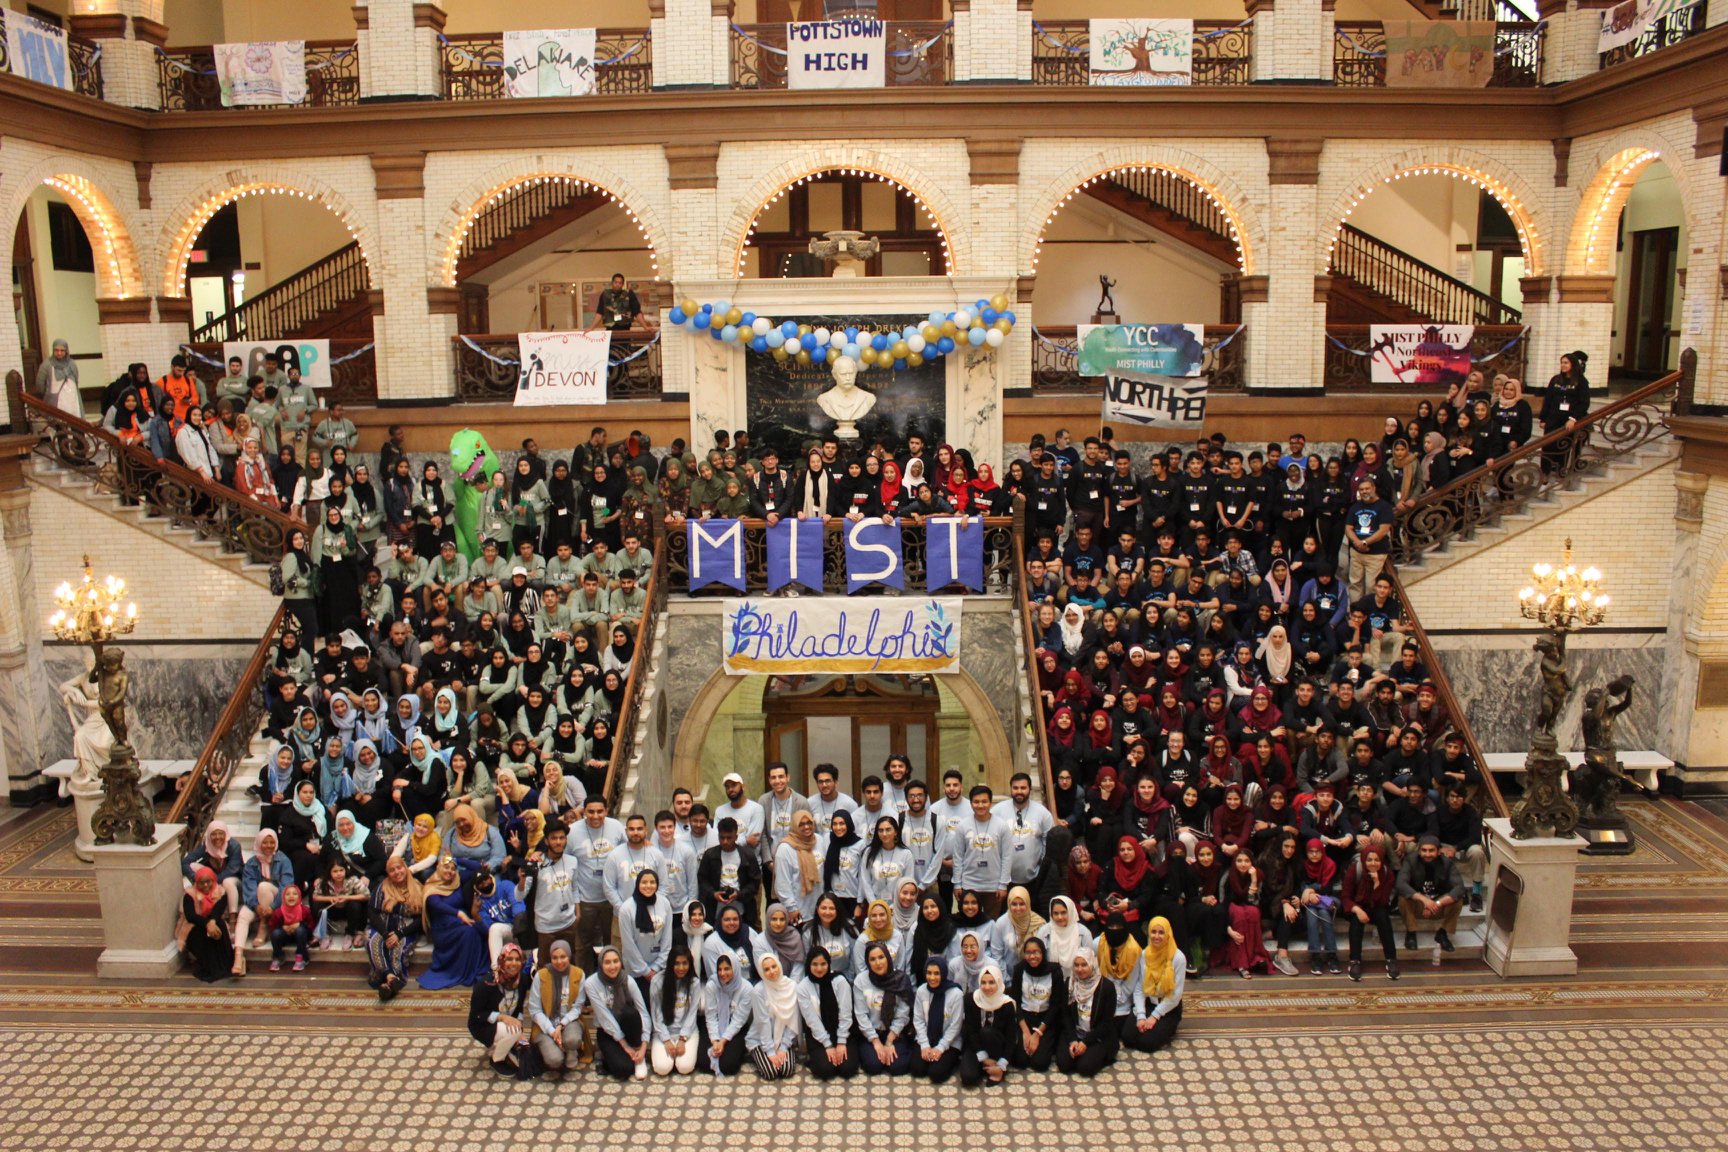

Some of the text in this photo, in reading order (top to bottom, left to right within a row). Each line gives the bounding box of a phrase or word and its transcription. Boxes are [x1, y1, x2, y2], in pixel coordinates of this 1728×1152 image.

[790, 20, 883, 41] POTTSTOWN
[504, 48, 594, 81] DELAWARE
[805, 53, 868, 71] HIGH
[1123, 326, 1158, 346] YCC
[1117, 360, 1165, 369] MIST PHILLY
[535, 371, 596, 388] DEVON
[692, 517, 979, 581] MIST
[728, 608, 955, 671] Philadelphia
